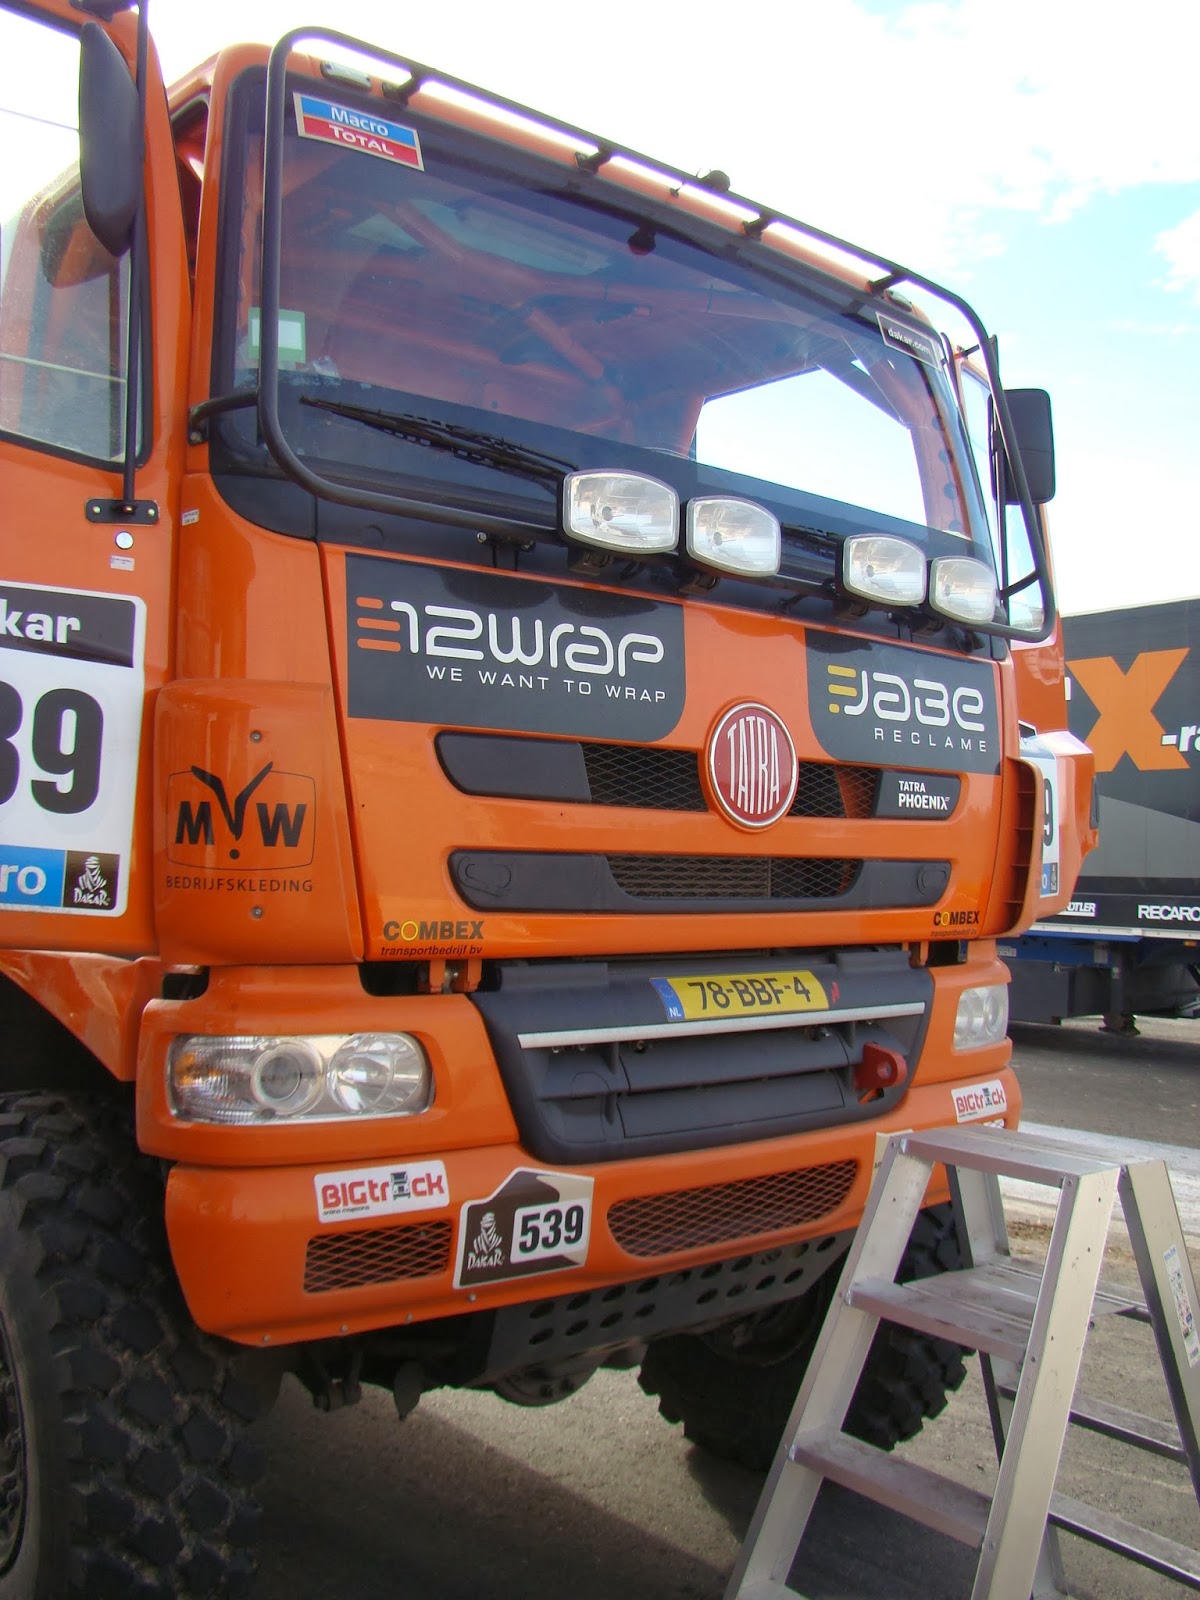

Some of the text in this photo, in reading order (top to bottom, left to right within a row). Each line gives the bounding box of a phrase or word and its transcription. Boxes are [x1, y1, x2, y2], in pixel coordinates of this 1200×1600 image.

[331, 106, 388, 136] Macro
[329, 124, 394, 155] TOTAL
[0, 599, 81, 644] kar
[426, 665, 666, 703] WE WANT TO WRAP
[874, 727, 987, 752] RECLAME
[727, 716, 780, 815] TATRA
[898, 780, 926, 793] TATRA
[898, 793, 948, 811] PHOENIX
[0, 864, 47, 896] ro
[166, 876, 313, 892] BEDRIJFSKLEDING
[74, 887, 109, 906] DAKAR
[933, 910, 980, 926] COMBEX
[1137, 904, 1200, 922] RECARO
[383, 920, 484, 941] COMBEX
[381, 945, 483, 957] transportbedrijf bv
[688, 976, 811, 1010] 78-BBF-4
[669, 1007, 682, 1018] NL
[518, 1205, 584, 1254] 539
[468, 1250, 504, 1270] DAKAR
